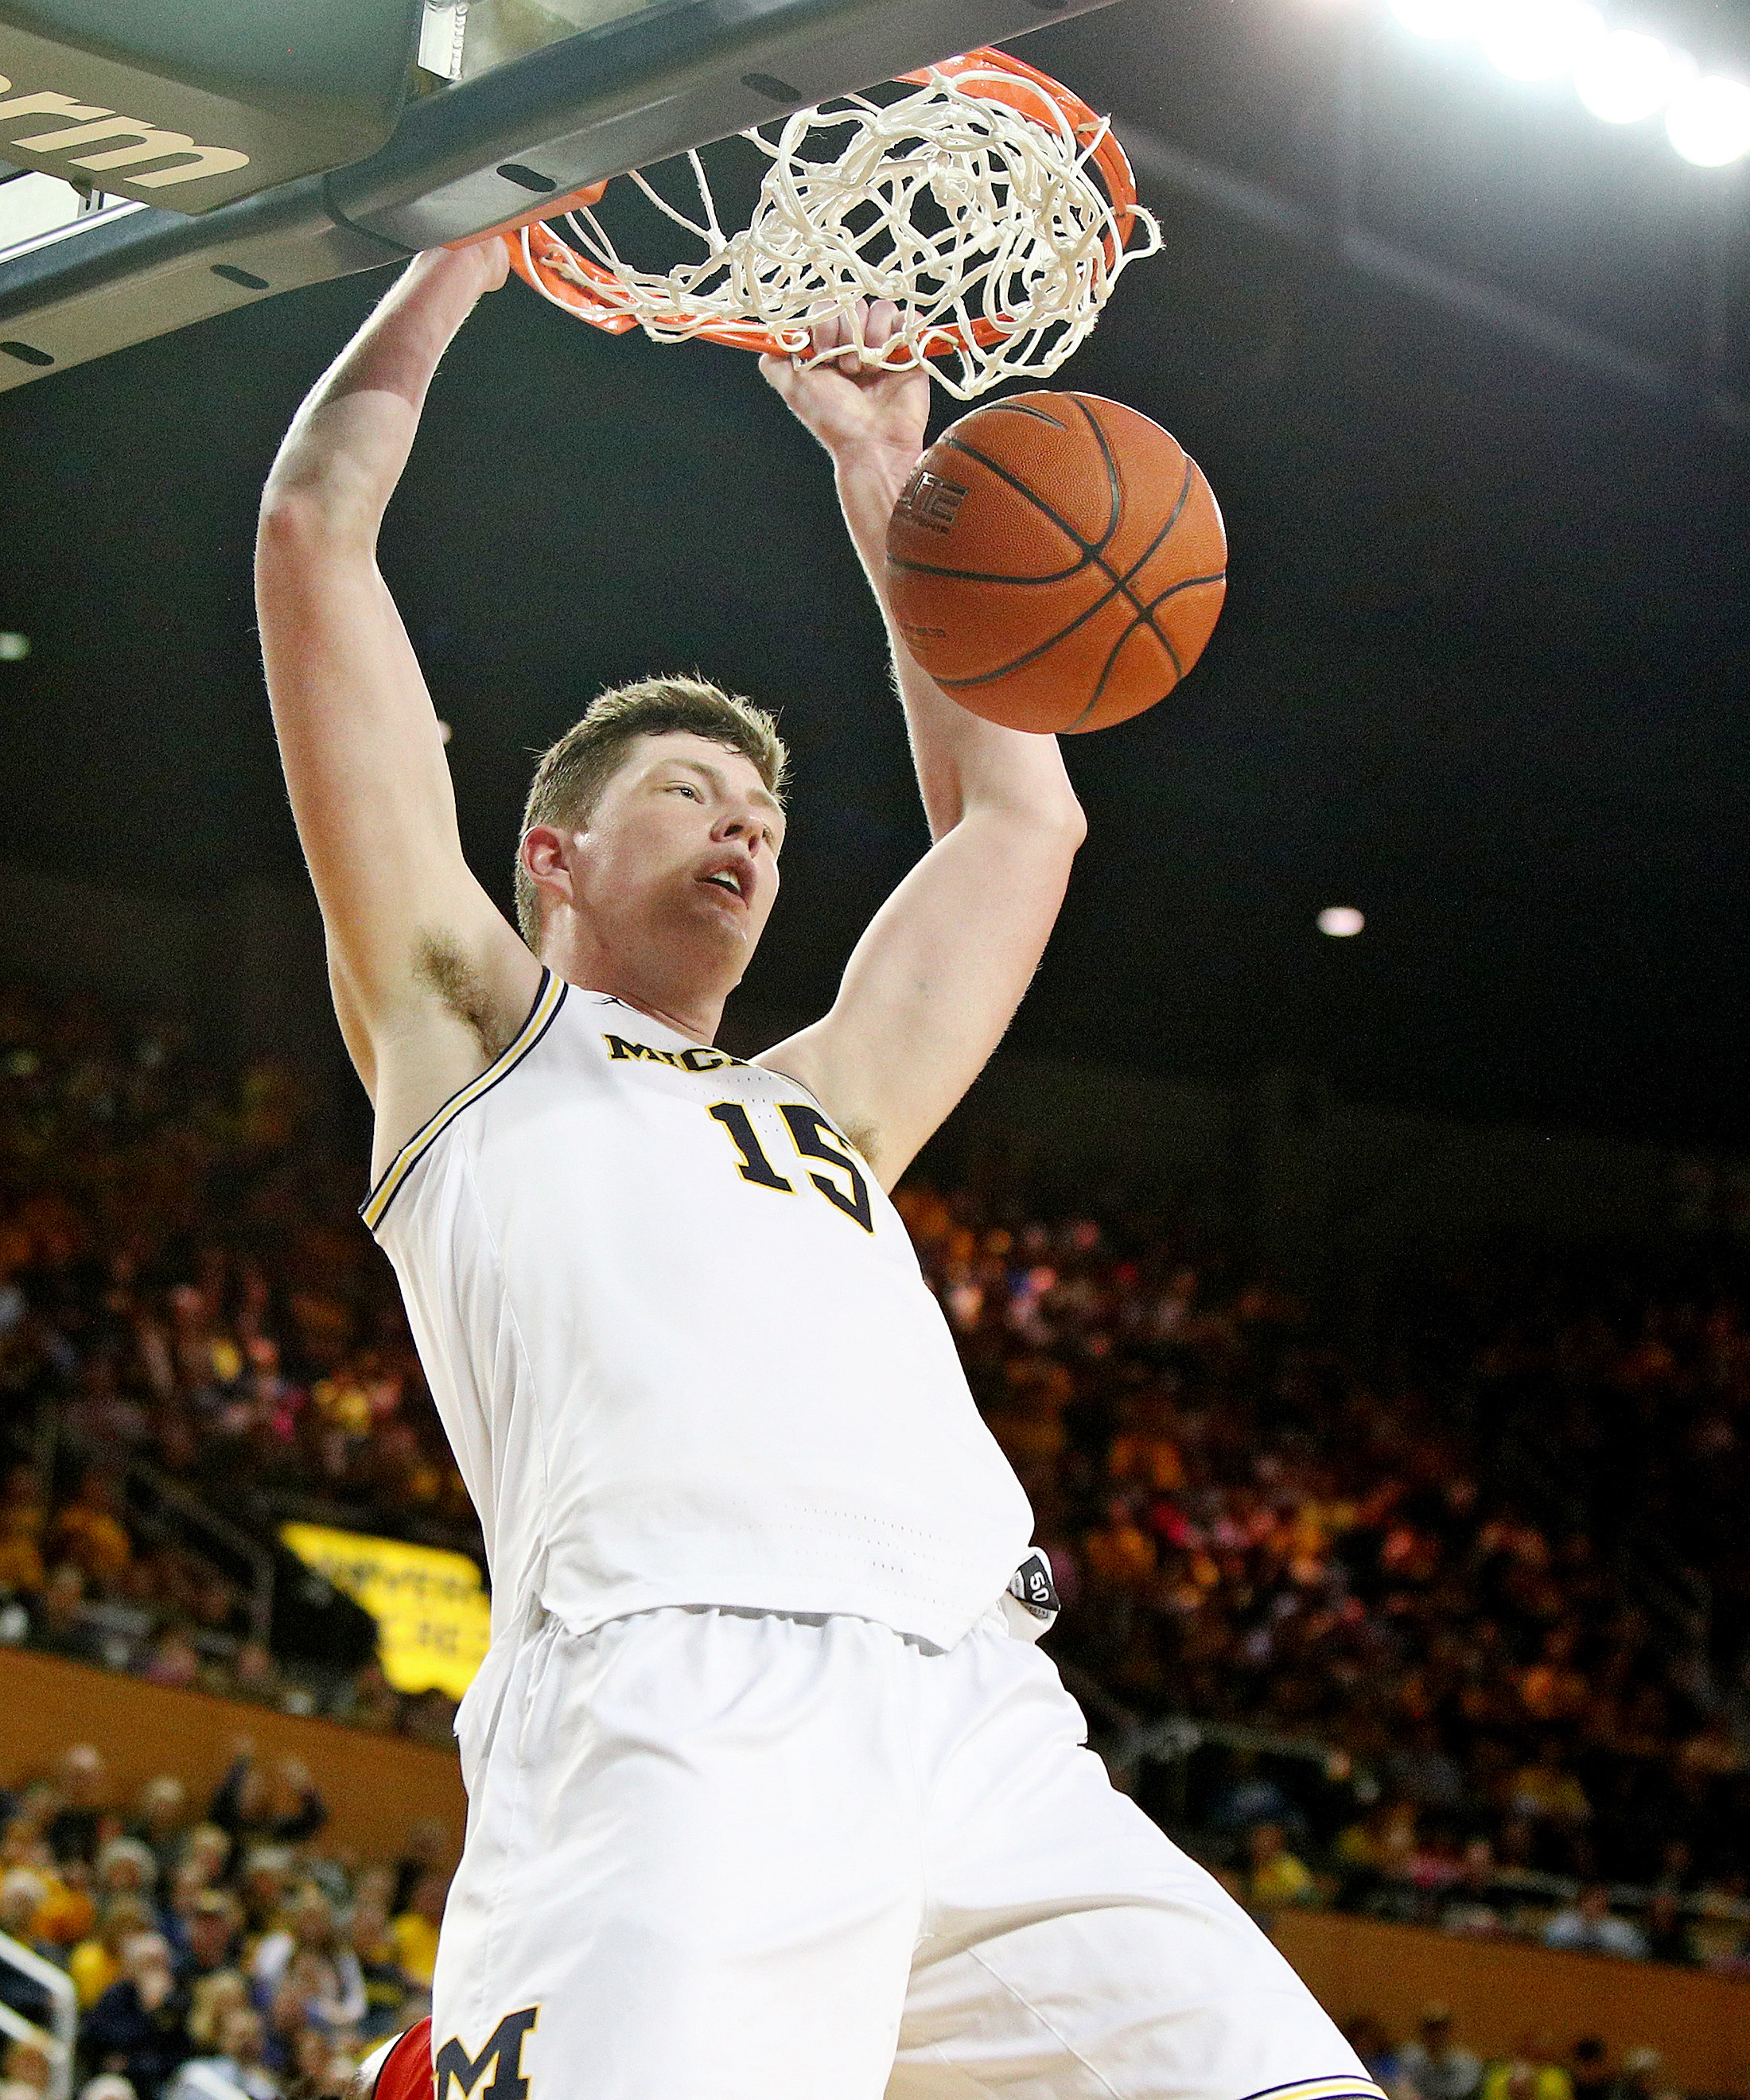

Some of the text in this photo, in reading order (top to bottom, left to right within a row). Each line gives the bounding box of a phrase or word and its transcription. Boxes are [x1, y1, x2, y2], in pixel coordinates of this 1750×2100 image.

[0, 73, 251, 189] rm
[601, 1033, 751, 1072] MIC
[706, 1101, 876, 1238] 15
[1029, 1570, 1050, 1603] 50
[430, 2004, 542, 2100] M
